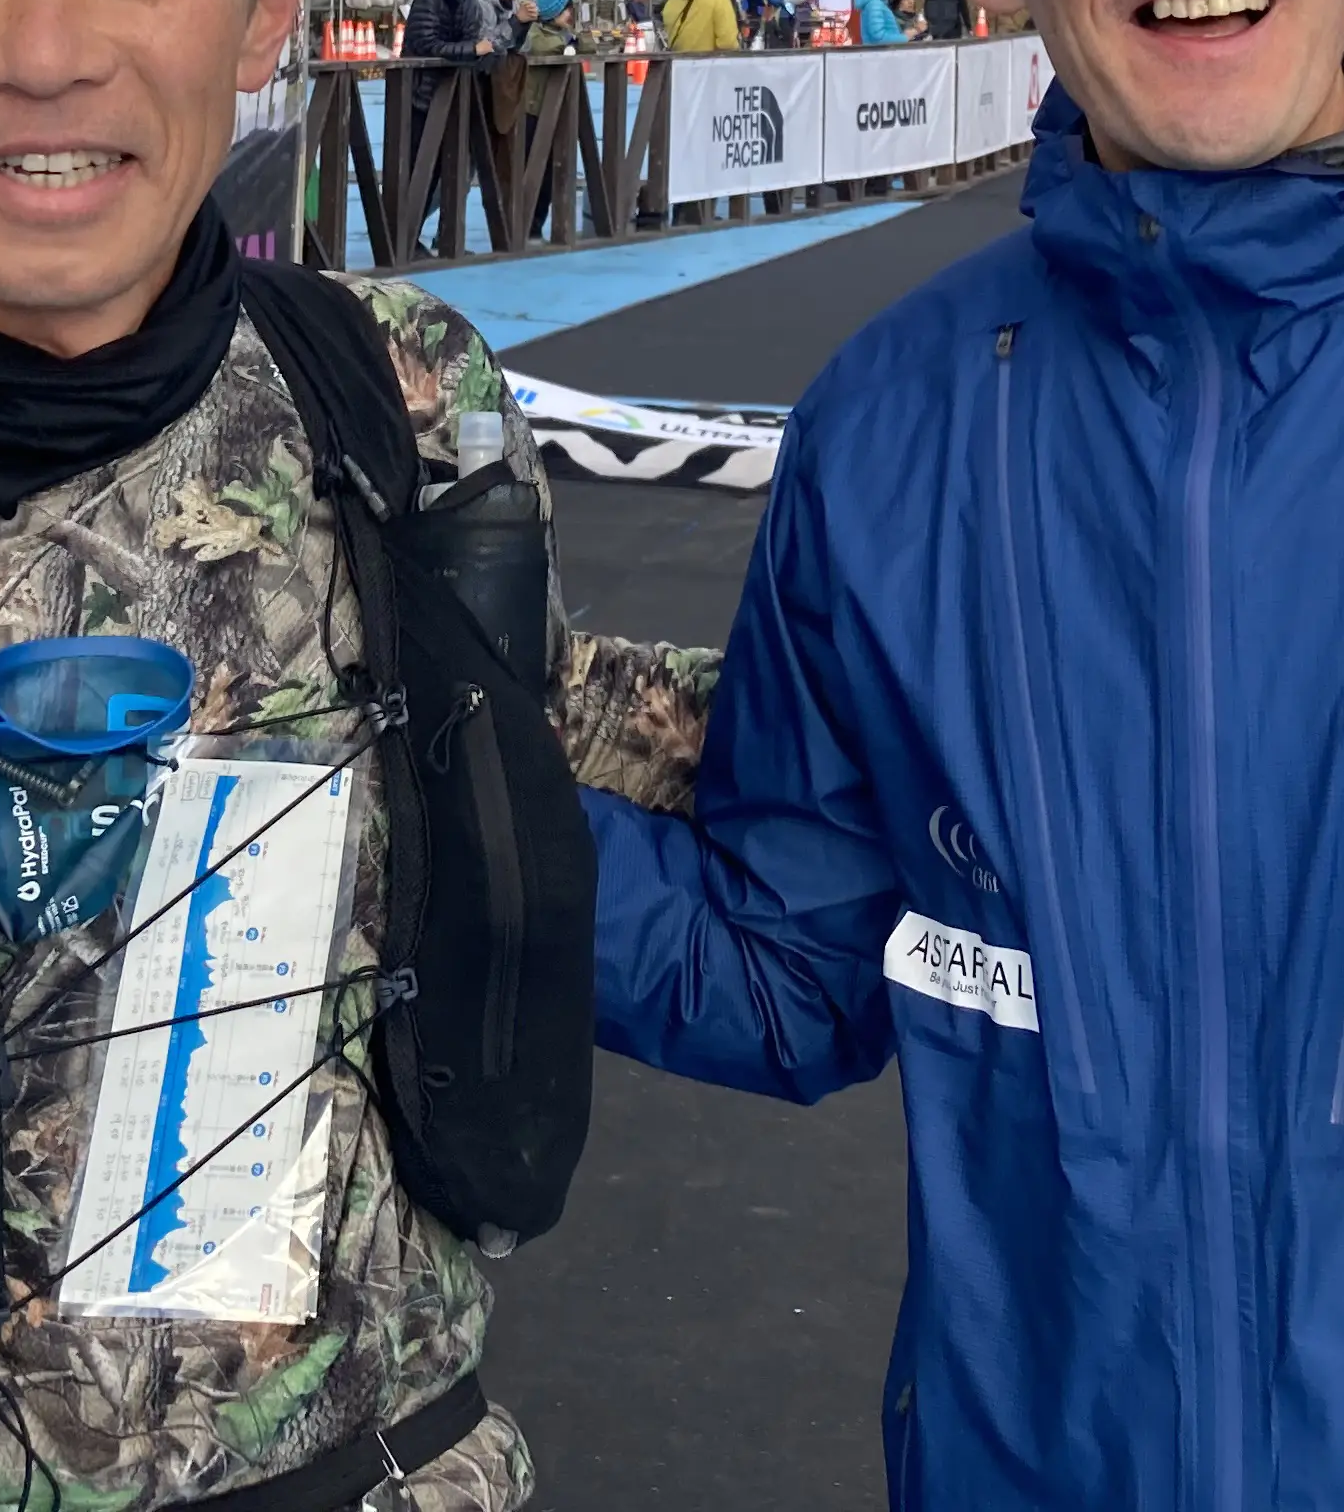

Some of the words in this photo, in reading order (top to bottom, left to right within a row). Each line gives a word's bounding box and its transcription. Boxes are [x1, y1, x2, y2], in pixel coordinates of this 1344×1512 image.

[735, 86, 760, 112] THE
[712, 114, 759, 142] NORTH
[726, 141, 759, 170] FACE
[907, 931, 1033, 1000] ASTARAL
